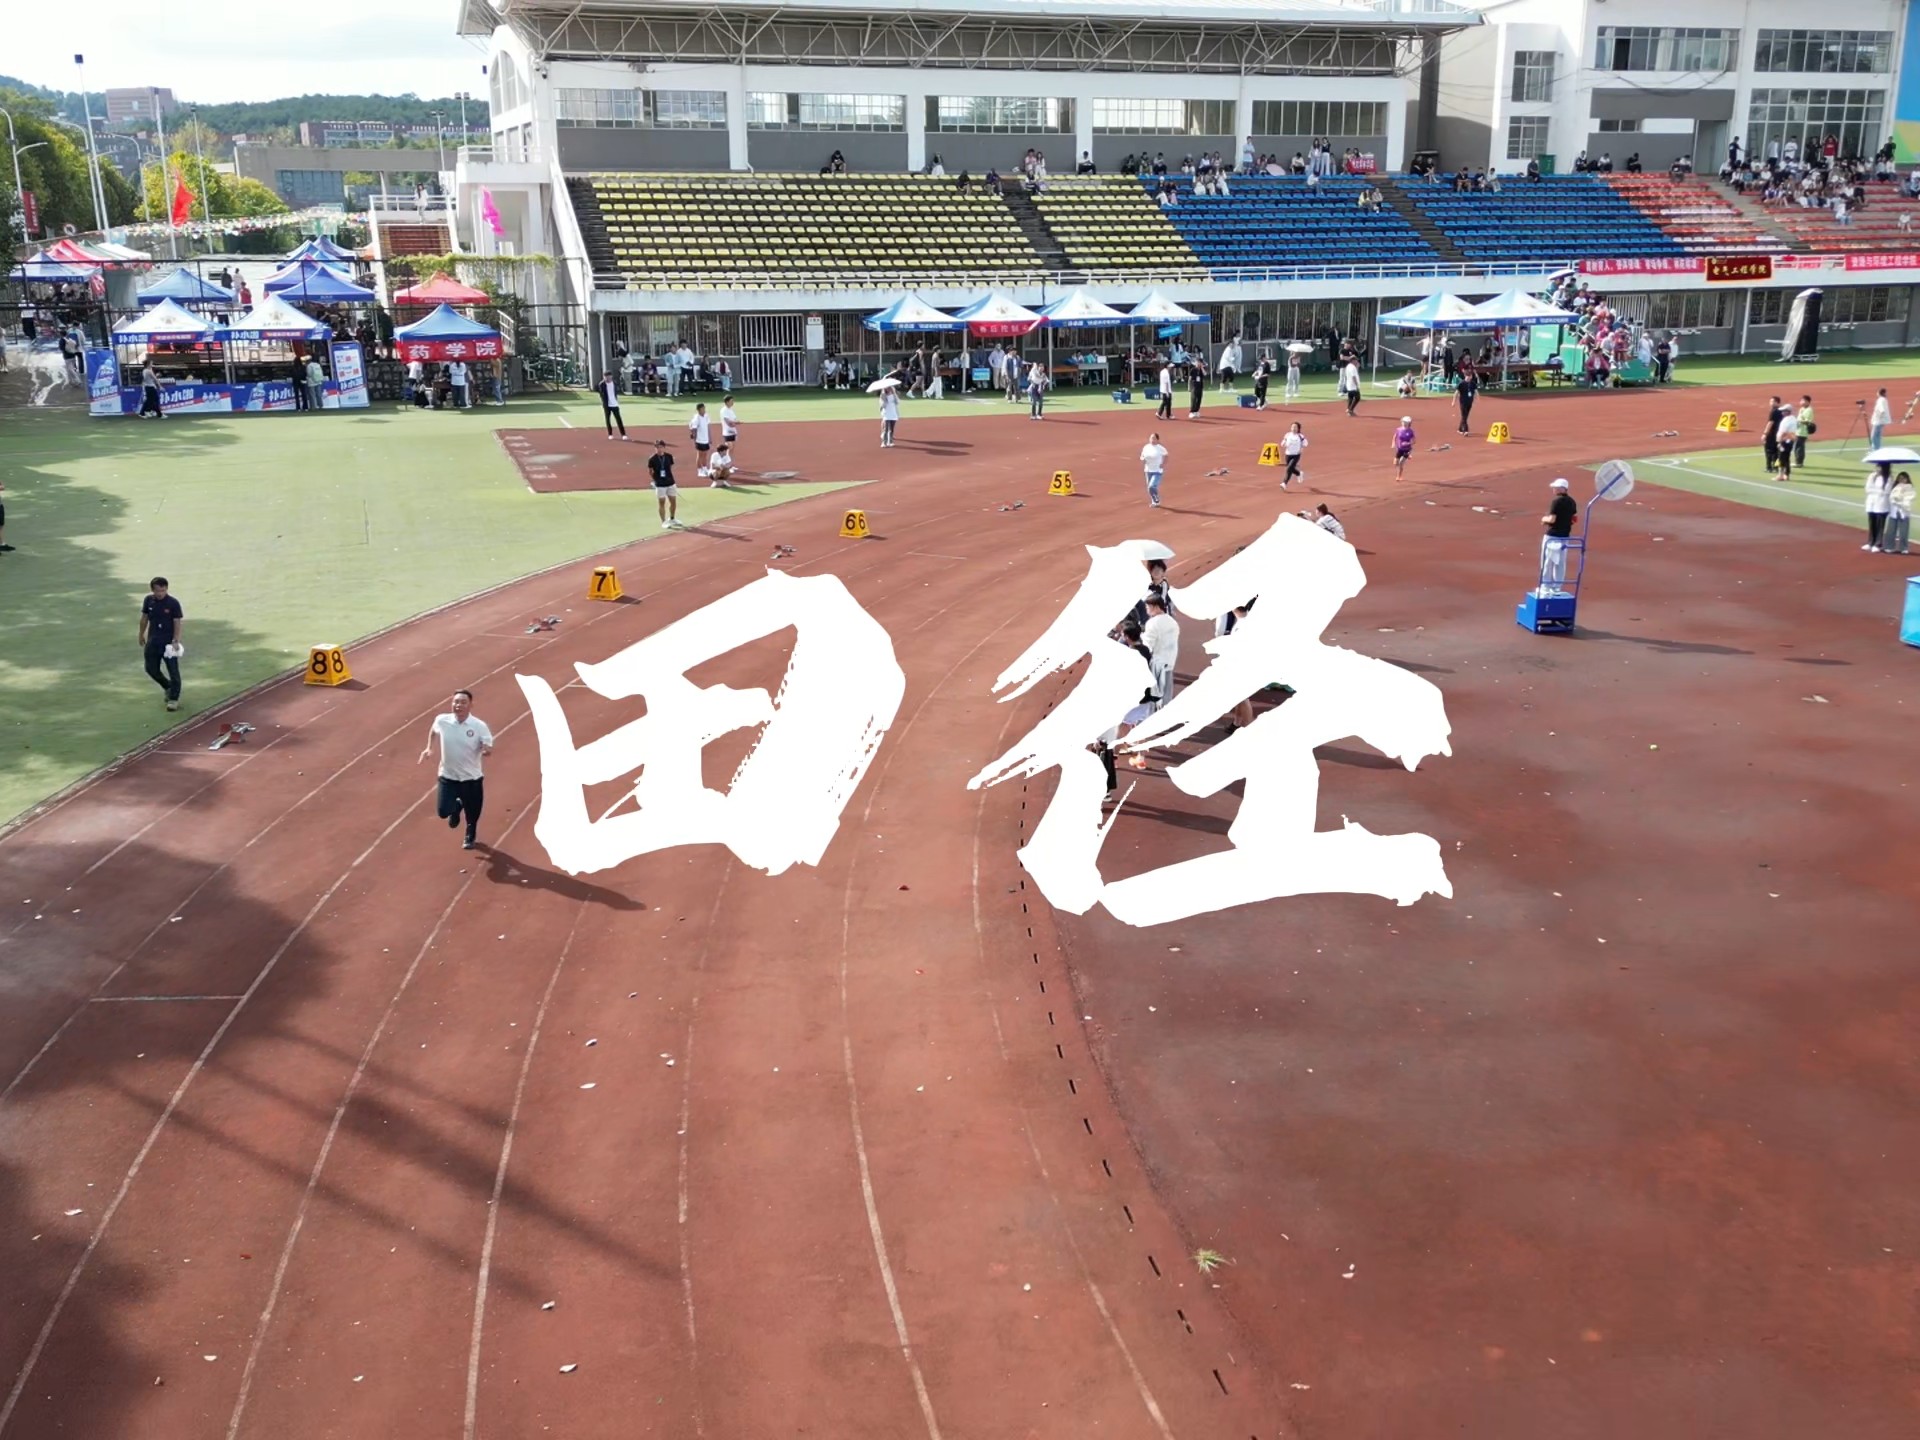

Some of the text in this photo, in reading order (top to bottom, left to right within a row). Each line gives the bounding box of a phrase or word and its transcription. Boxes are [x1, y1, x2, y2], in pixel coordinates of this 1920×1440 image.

[1712, 264, 1767, 276] 电气工程学院
[408, 341, 497, 360] 药学院
